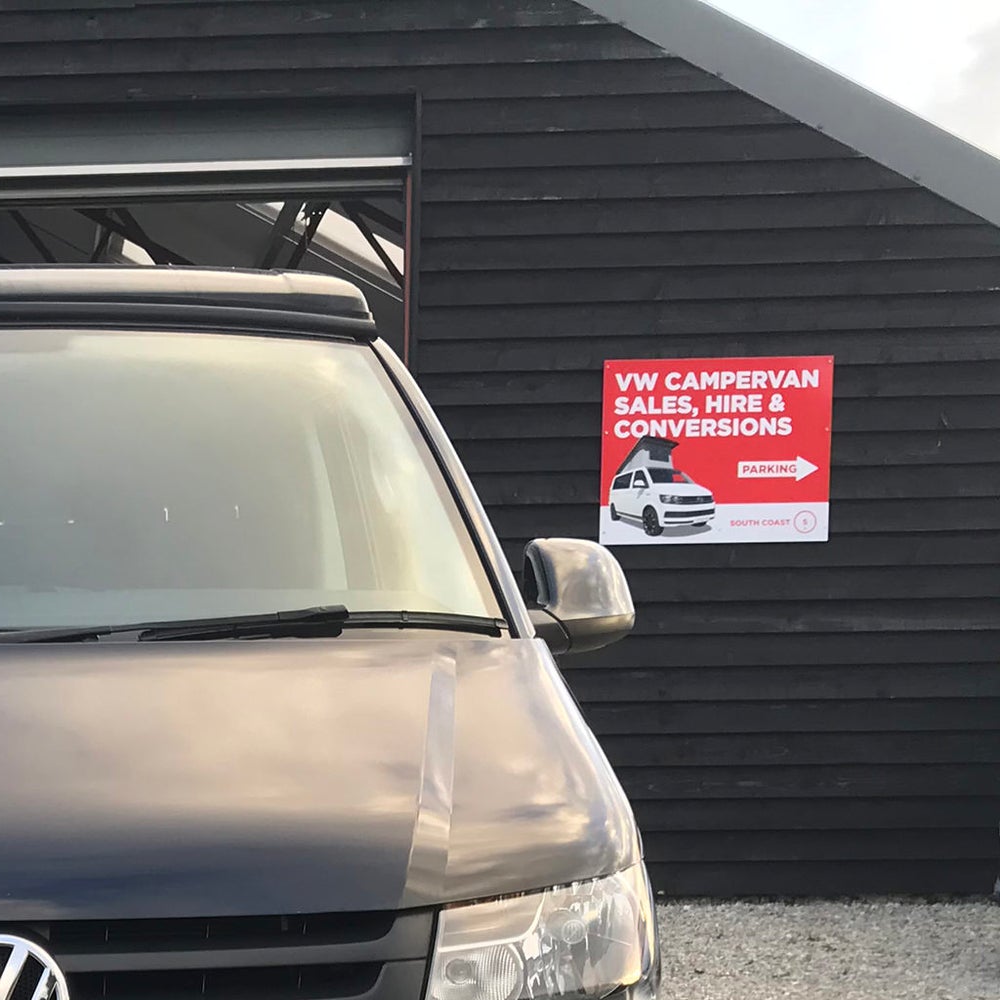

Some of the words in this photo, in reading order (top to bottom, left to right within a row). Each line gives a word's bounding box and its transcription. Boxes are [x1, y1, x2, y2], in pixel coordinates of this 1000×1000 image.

[614, 372, 659, 392] VW
[664, 369, 820, 391] CAMPERVAN
[614, 395, 699, 417] SALES,
[705, 394, 763, 414] HIRE
[768, 393, 786, 413] &
[613, 417, 793, 438] CONVERSIONS
[742, 464, 797, 475] PARKING
[730, 519, 760, 527] SOUTH
